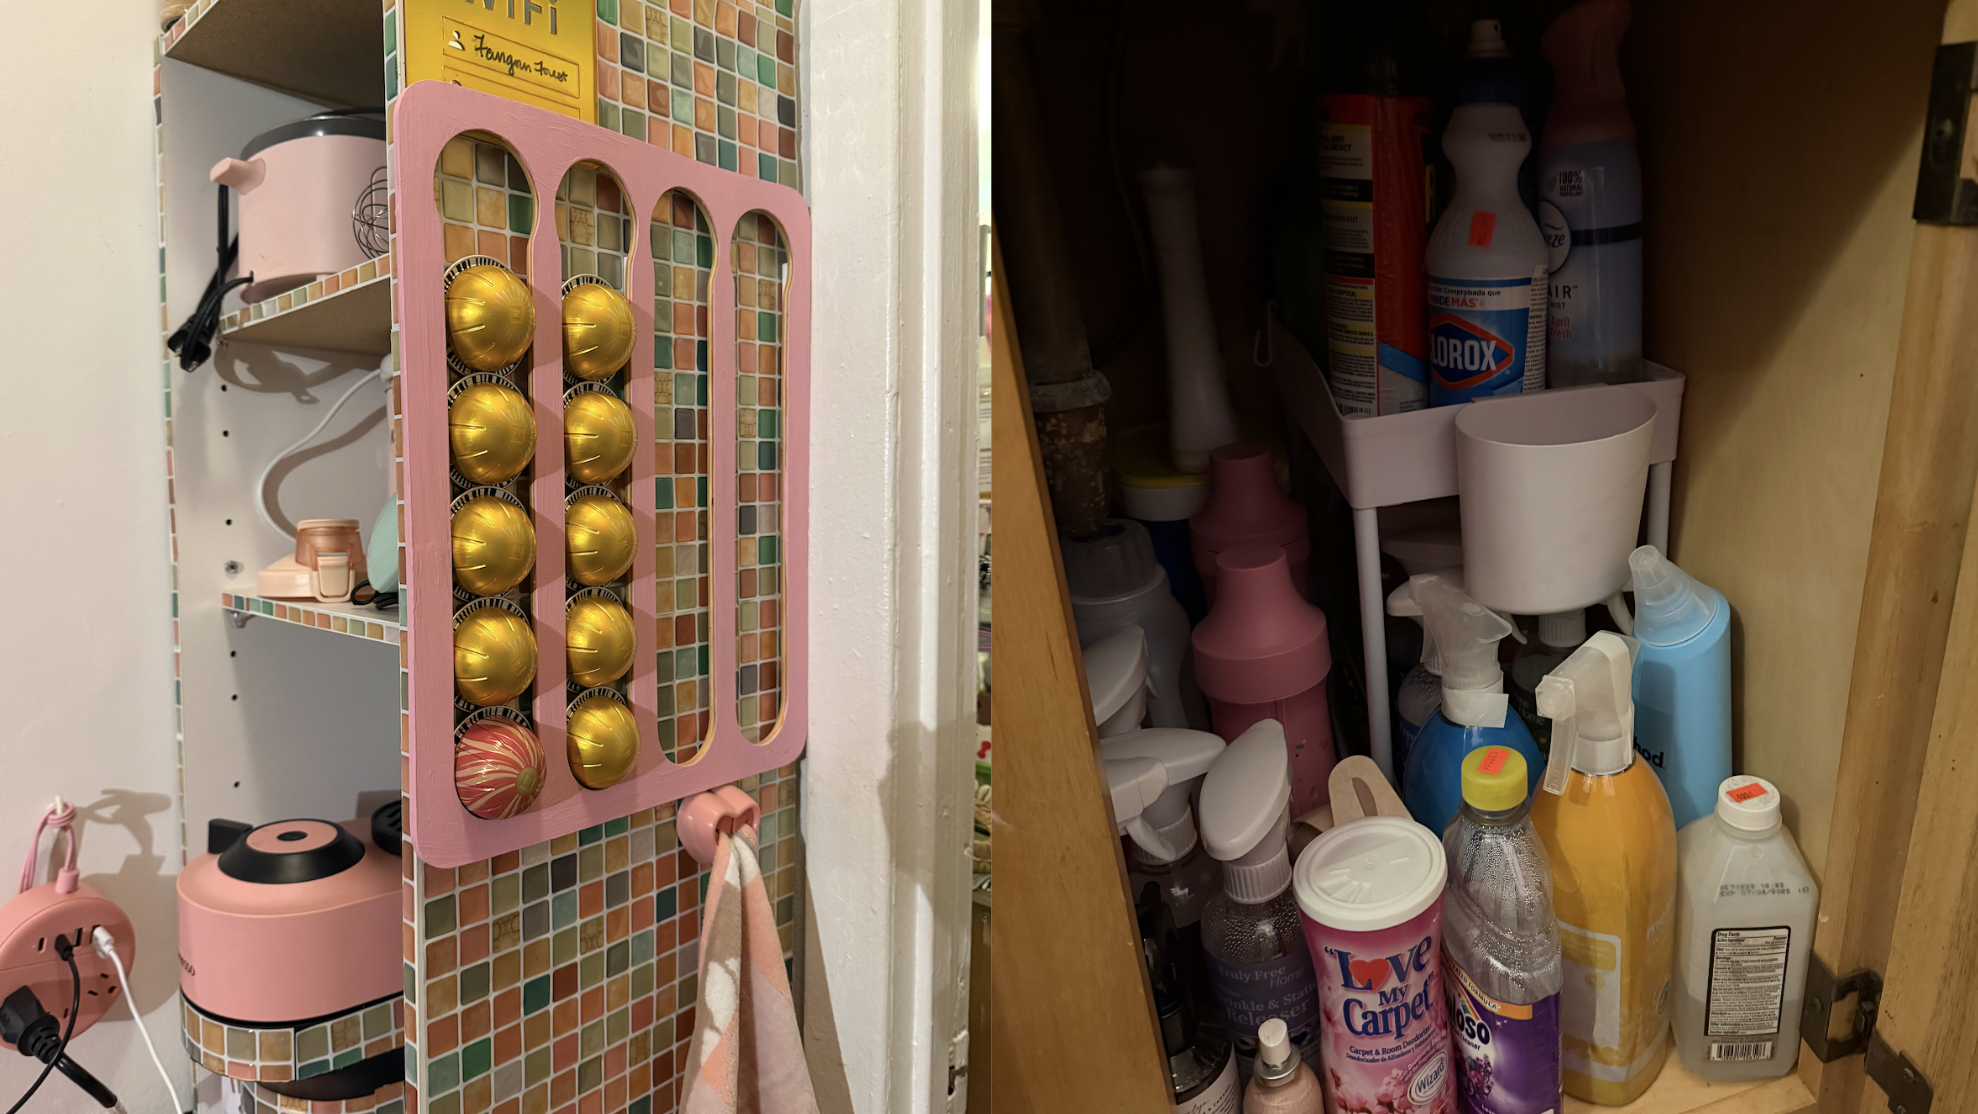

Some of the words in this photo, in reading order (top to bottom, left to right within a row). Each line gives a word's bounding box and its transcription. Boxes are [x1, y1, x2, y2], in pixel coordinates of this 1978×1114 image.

[1558, 170, 1583, 185] 100%
[1443, 286, 1486, 297] Comprobada
[1550, 302, 1566, 310] MIST
[1551, 316, 1570, 329] April
[1550, 328, 1572, 340] Fresh
[1430, 334, 1497, 371] LOROX
[1217, 964, 1251, 984] Truly
[1255, 966, 1287, 980] Free
[1270, 965, 1305, 988] Home
[1268, 998, 1280, 1010] &
[1227, 998, 1310, 1027] Releser
[1349, 1045, 1374, 1058] Carpet
[1374, 1048, 1381, 1056] &
[1381, 1044, 1402, 1056] Room
[1416, 1060, 1445, 1093] Wizard
